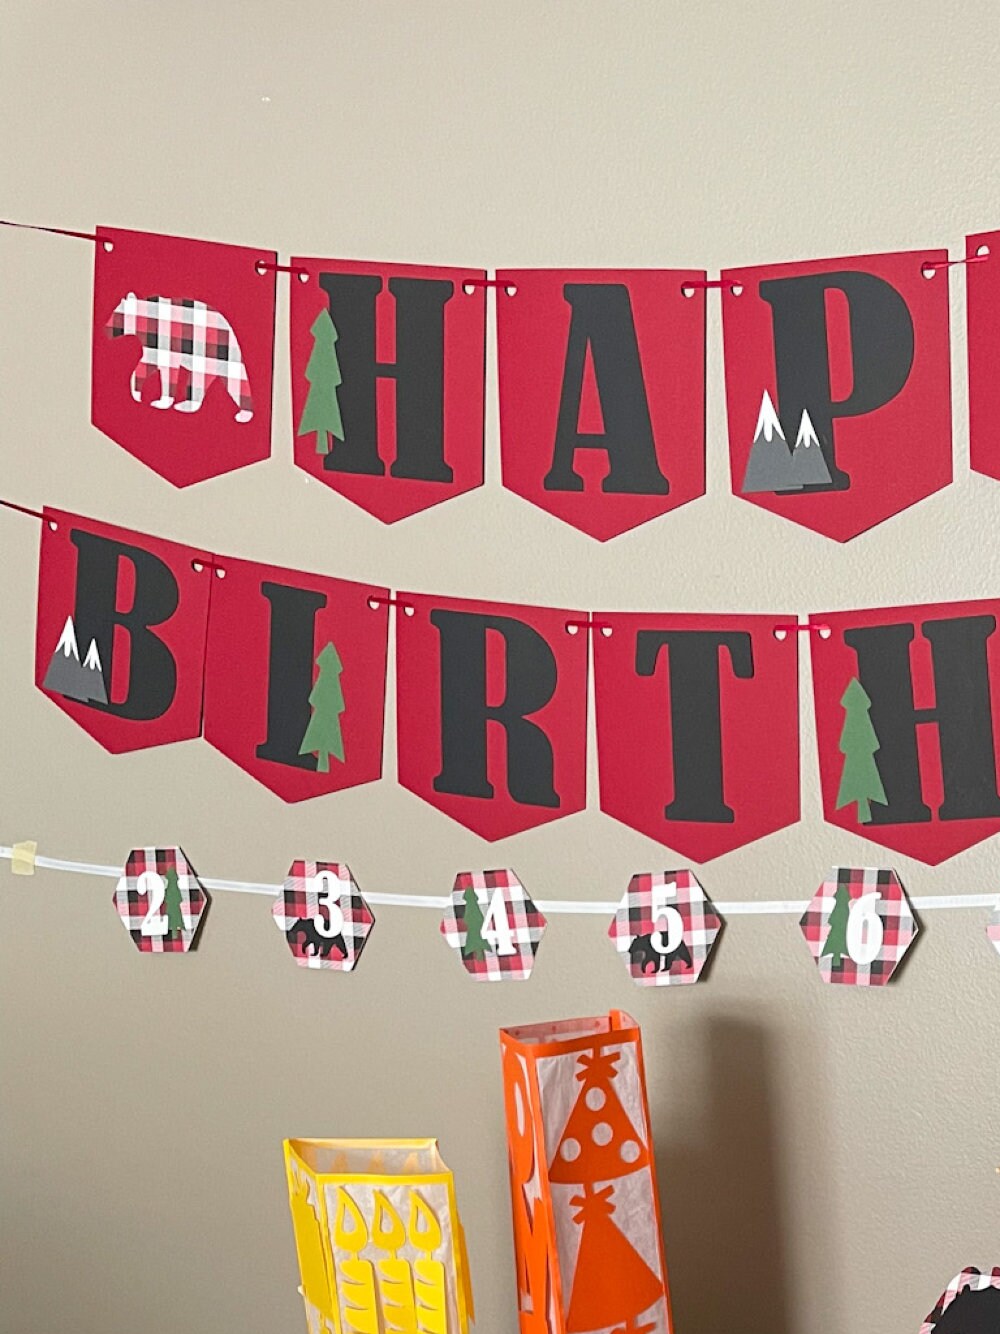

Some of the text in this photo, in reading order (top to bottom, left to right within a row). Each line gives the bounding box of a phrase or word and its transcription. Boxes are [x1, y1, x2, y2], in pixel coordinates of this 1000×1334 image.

[136, 870, 169, 937] 2
[312, 870, 345, 939] 3
[480, 886, 517, 956] 4
[649, 881, 685, 954] 5
[846, 891, 884, 966] 6
